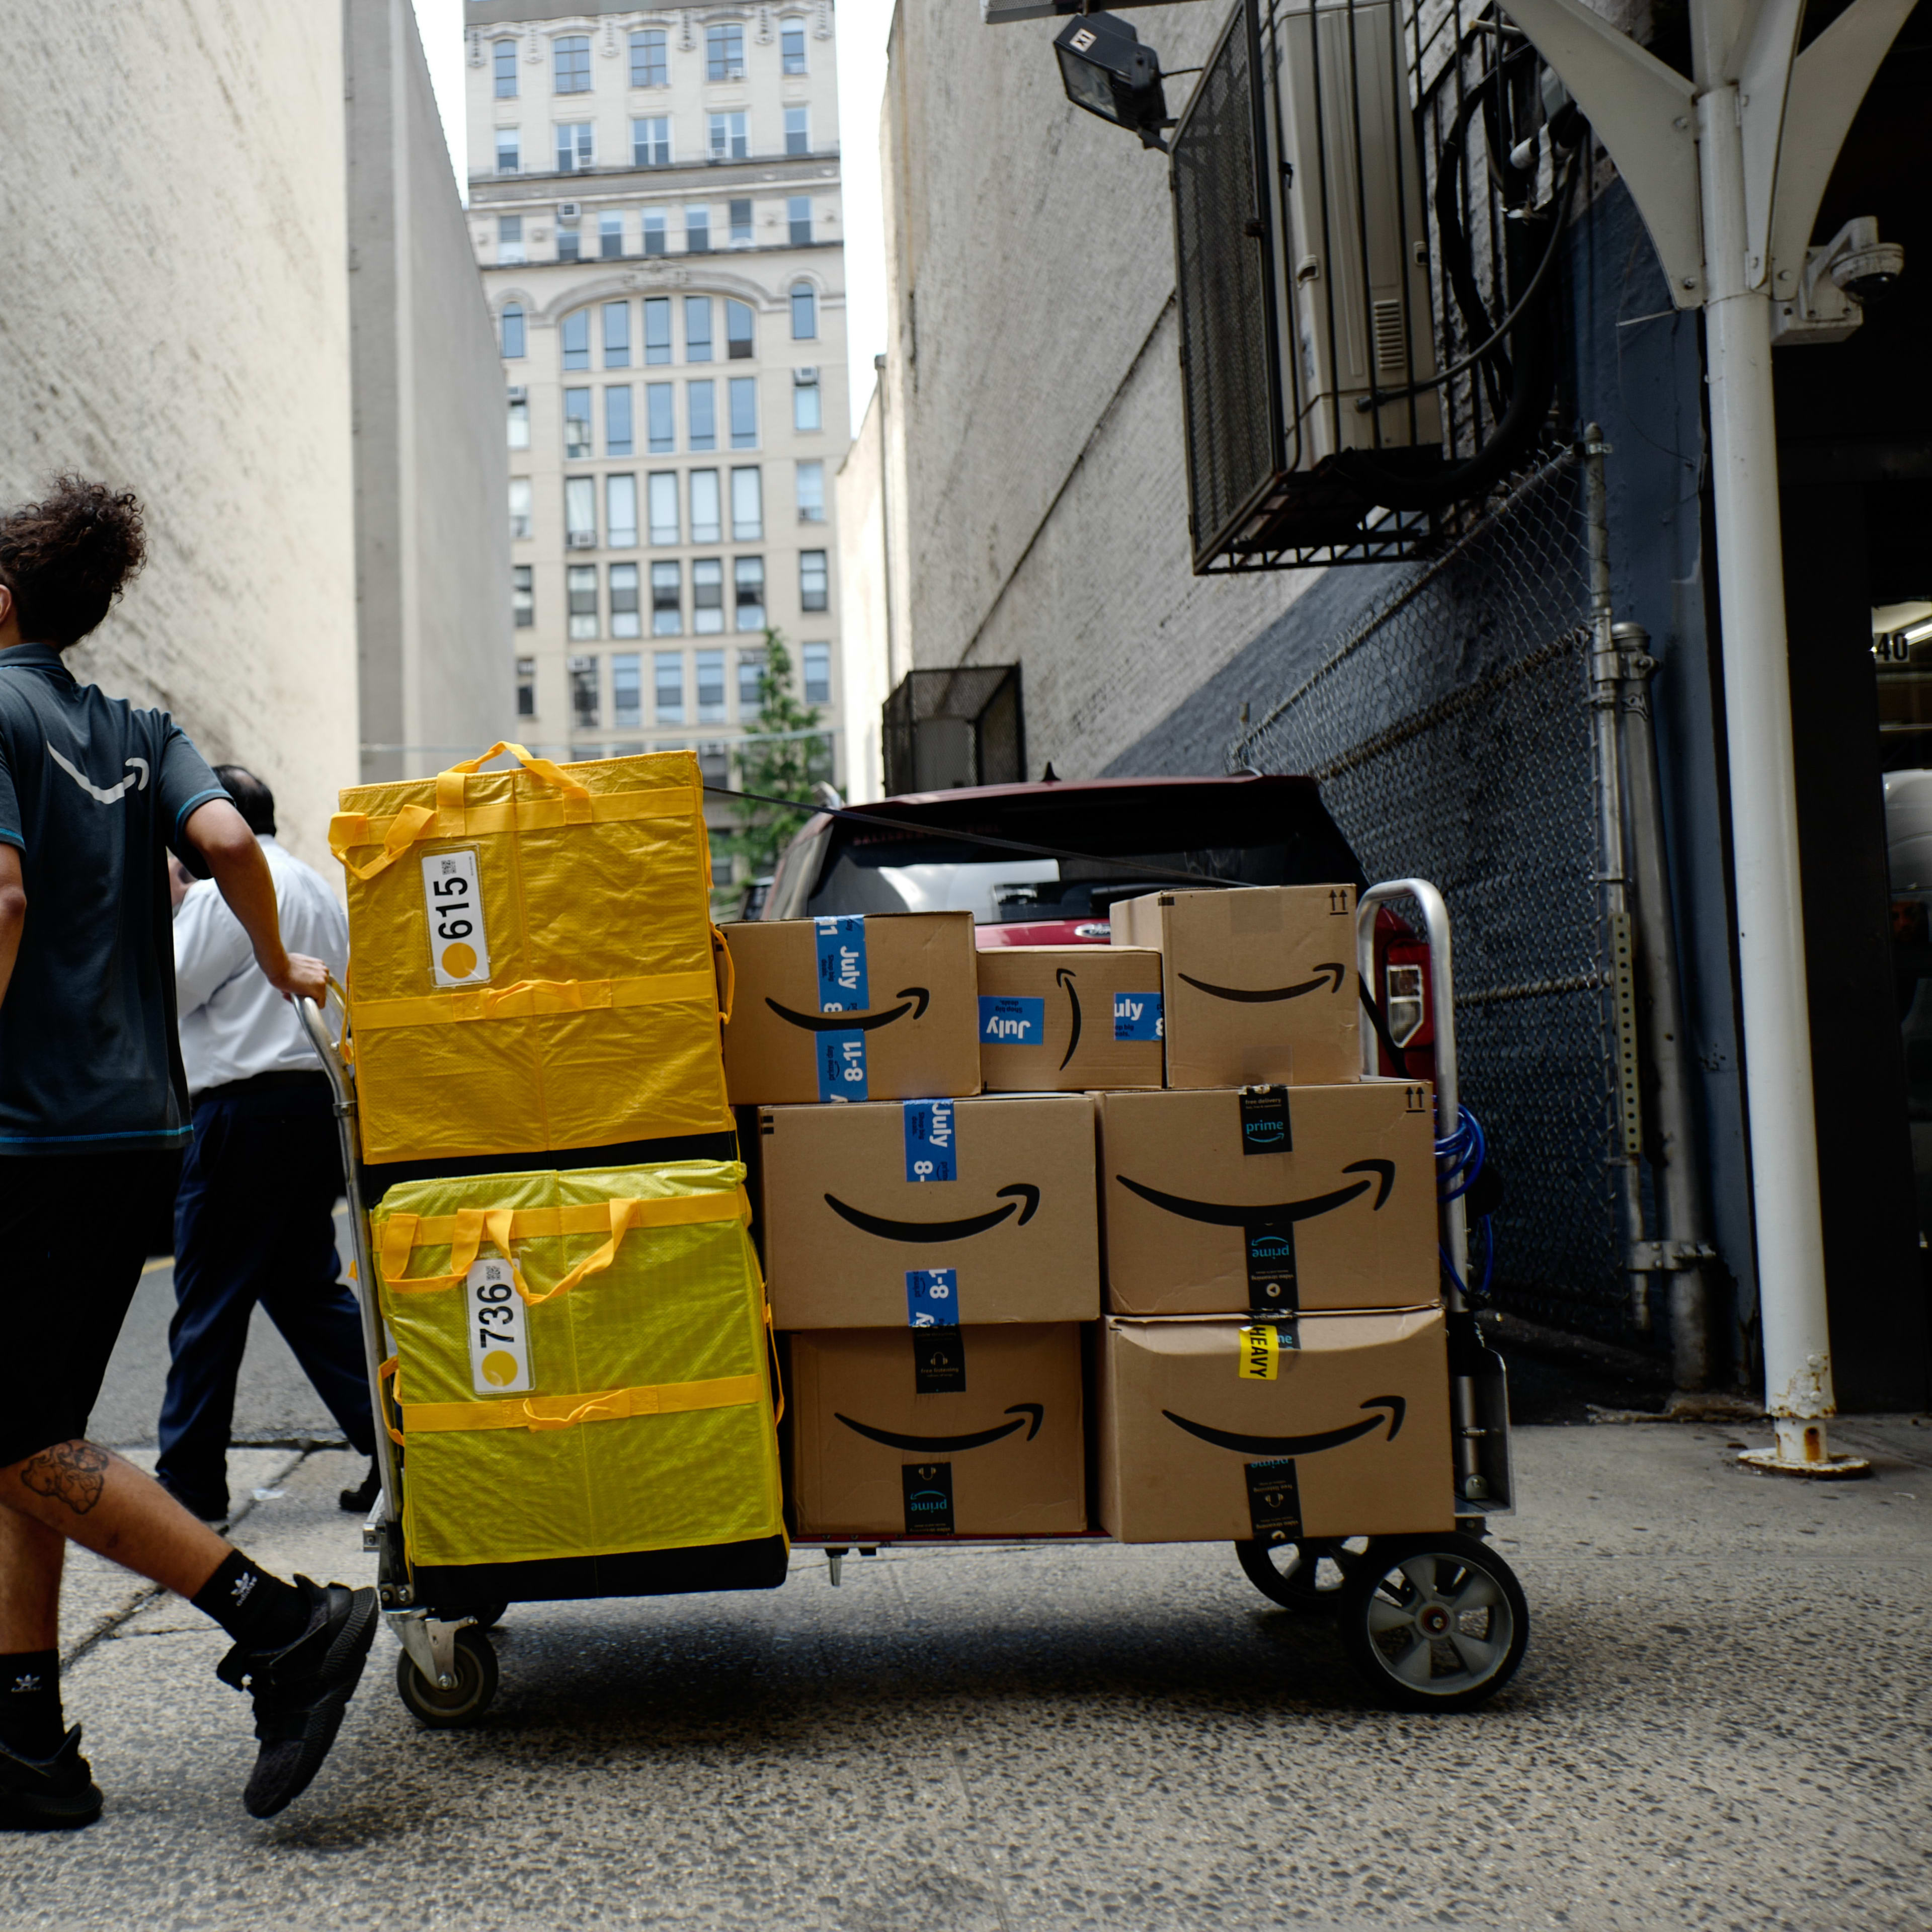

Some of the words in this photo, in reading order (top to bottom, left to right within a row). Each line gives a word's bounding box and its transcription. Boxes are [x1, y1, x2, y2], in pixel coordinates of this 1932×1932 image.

[433, 877, 472, 939] 615
[838, 945, 860, 990] July
[986, 1016, 1031, 1039] July
[843, 1041, 863, 1081] 8-11
[929, 1103, 951, 1148] July
[1246, 1119, 1284, 1135] prime
[1251, 1244, 1290, 1260] prime
[476, 1283, 514, 1348] 736
[1249, 1326, 1268, 1378] HEAVY
[910, 1498, 947, 1513] prime
